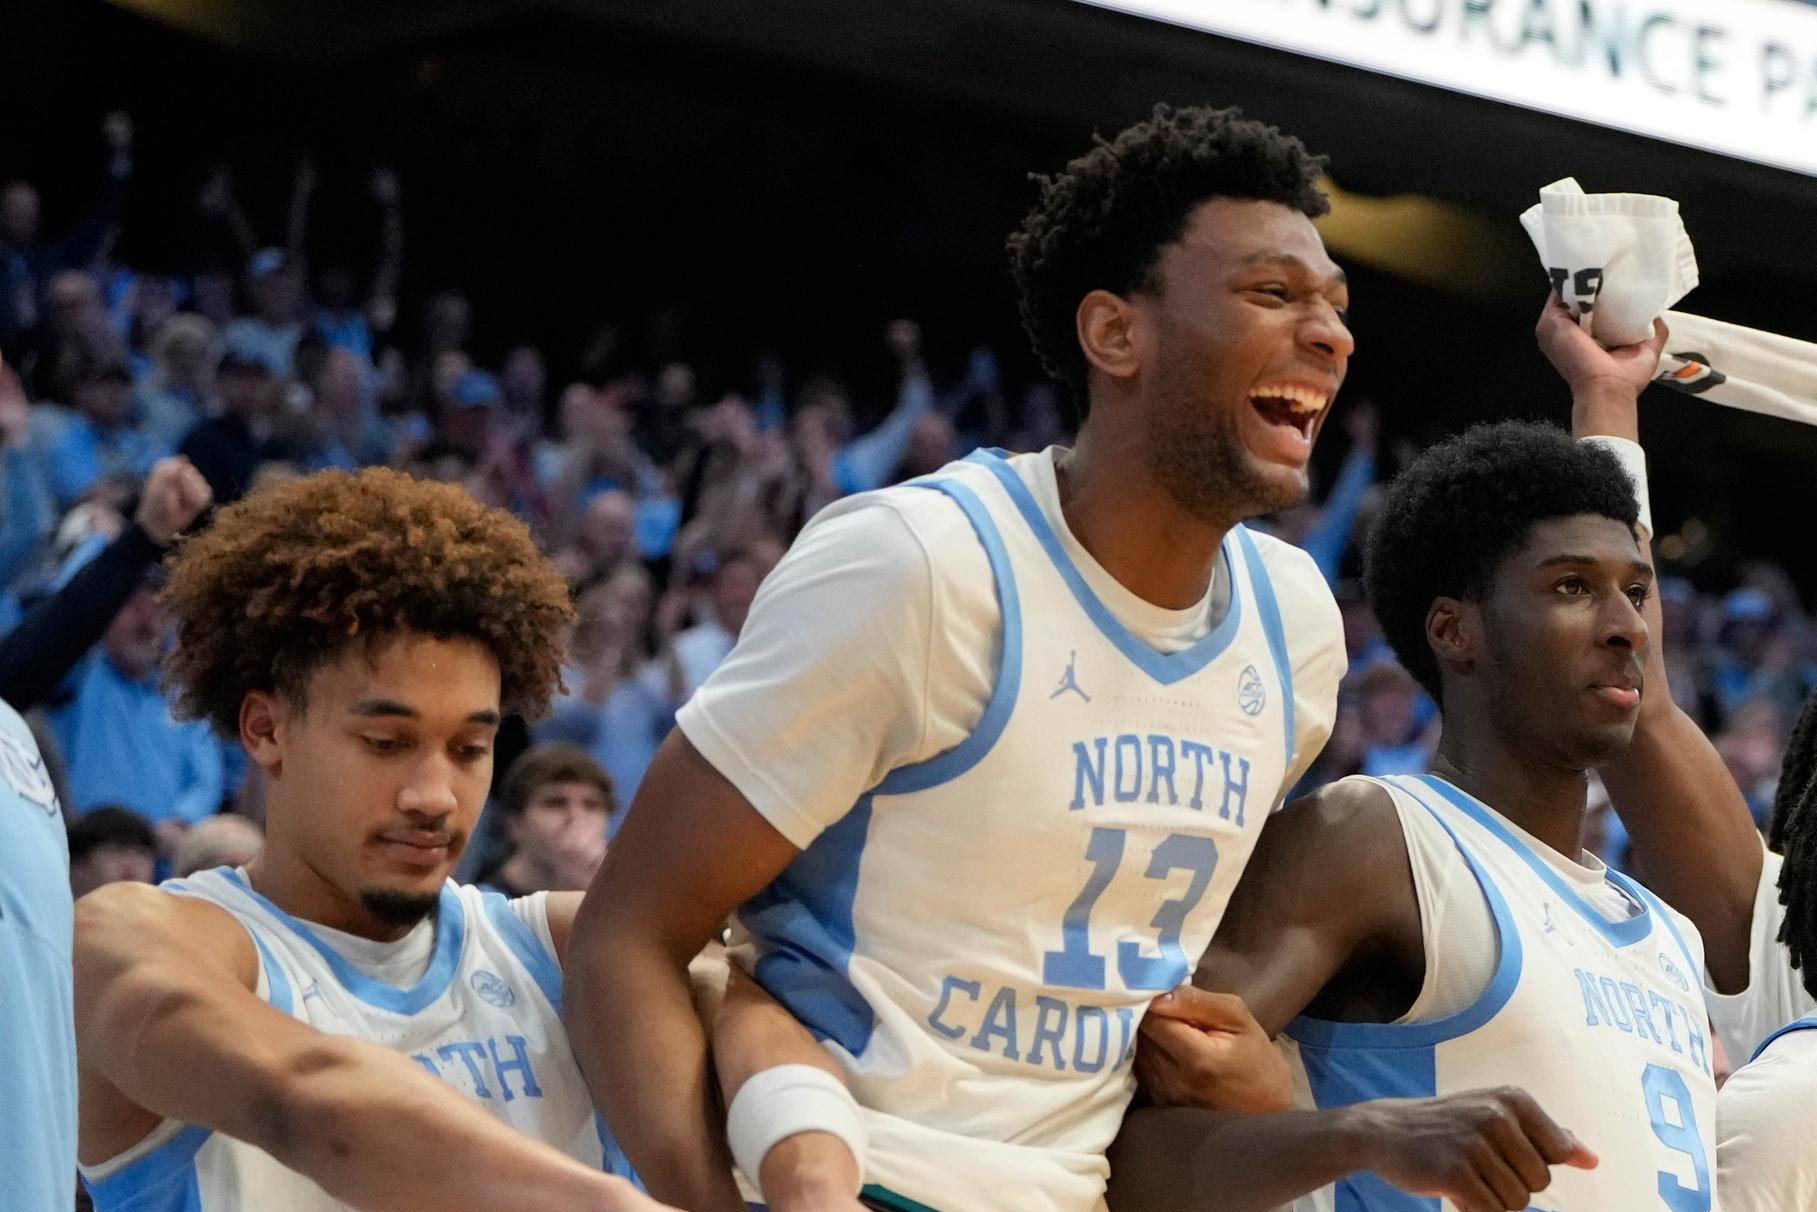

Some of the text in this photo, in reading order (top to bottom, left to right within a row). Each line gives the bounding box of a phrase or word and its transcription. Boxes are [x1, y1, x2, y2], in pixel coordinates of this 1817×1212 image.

[1069, 734, 1249, 828] NORTH
[1043, 827, 1219, 990] 13
[1575, 968, 1711, 1076] NORTH
